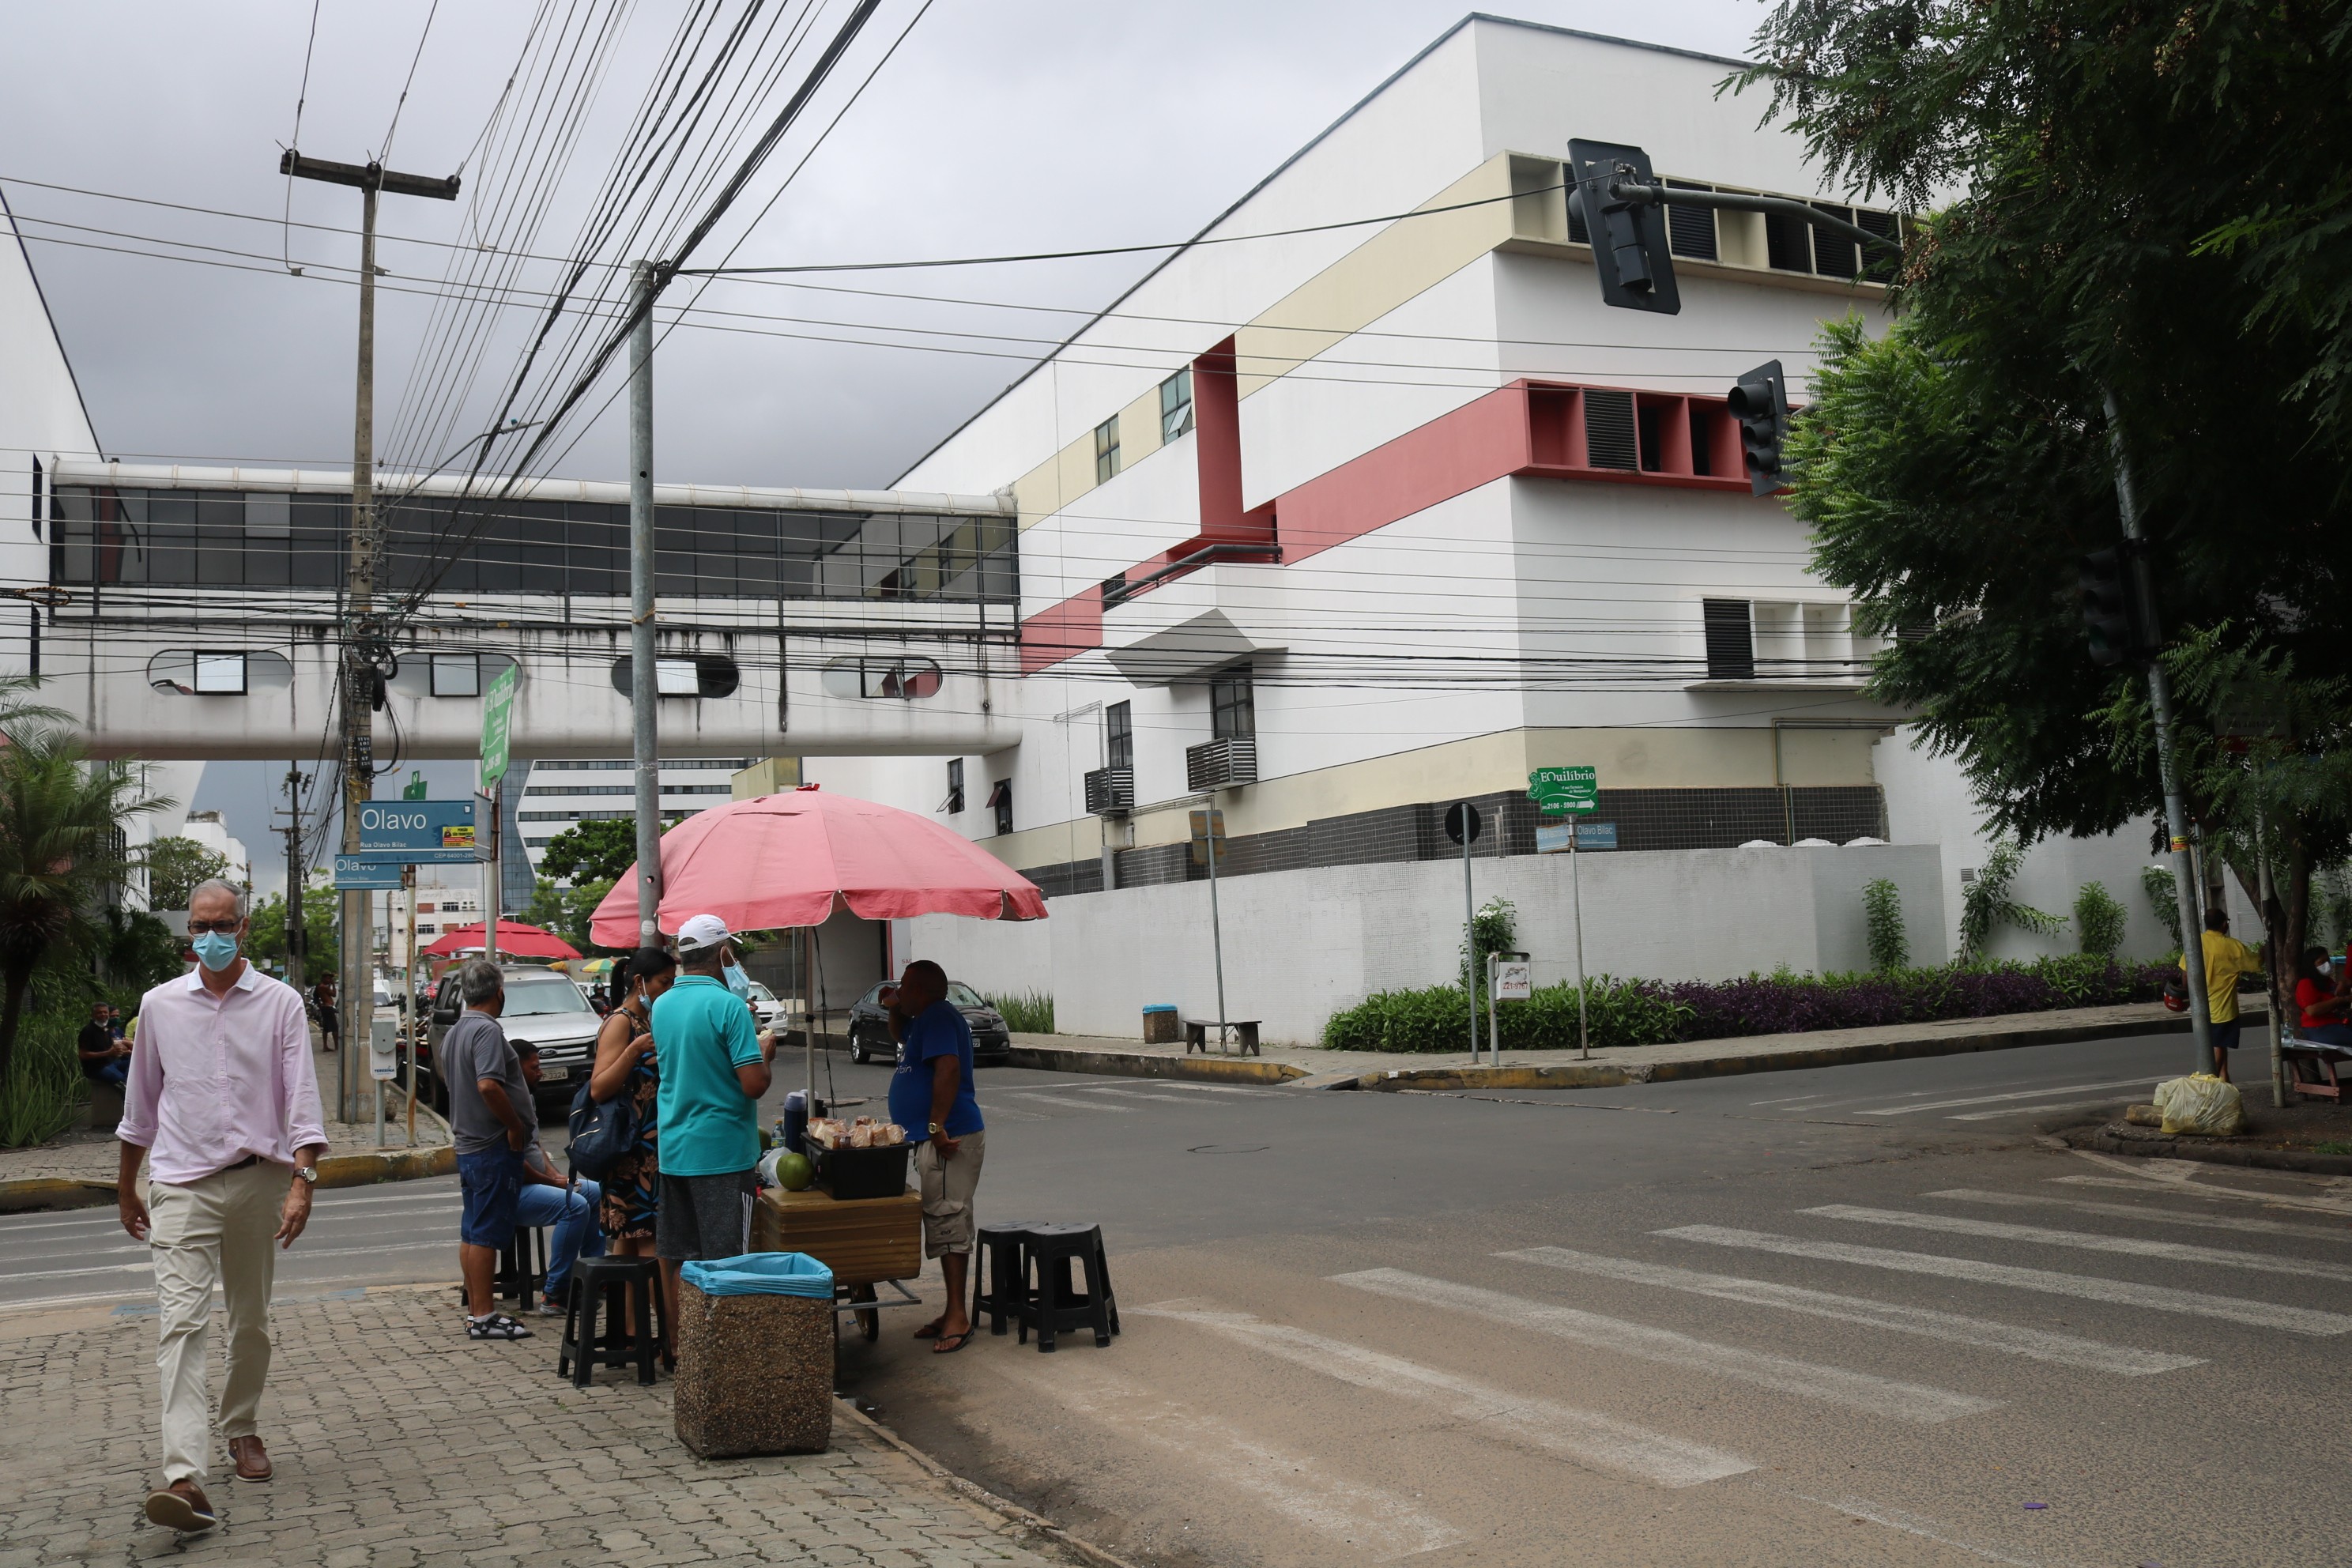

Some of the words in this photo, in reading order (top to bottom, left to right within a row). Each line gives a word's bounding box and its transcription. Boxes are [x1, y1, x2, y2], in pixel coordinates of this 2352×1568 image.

[361, 808, 427, 830] Olavo
[1577, 825, 1596, 835] Olavo
[1597, 824, 1613, 835] Bilac
